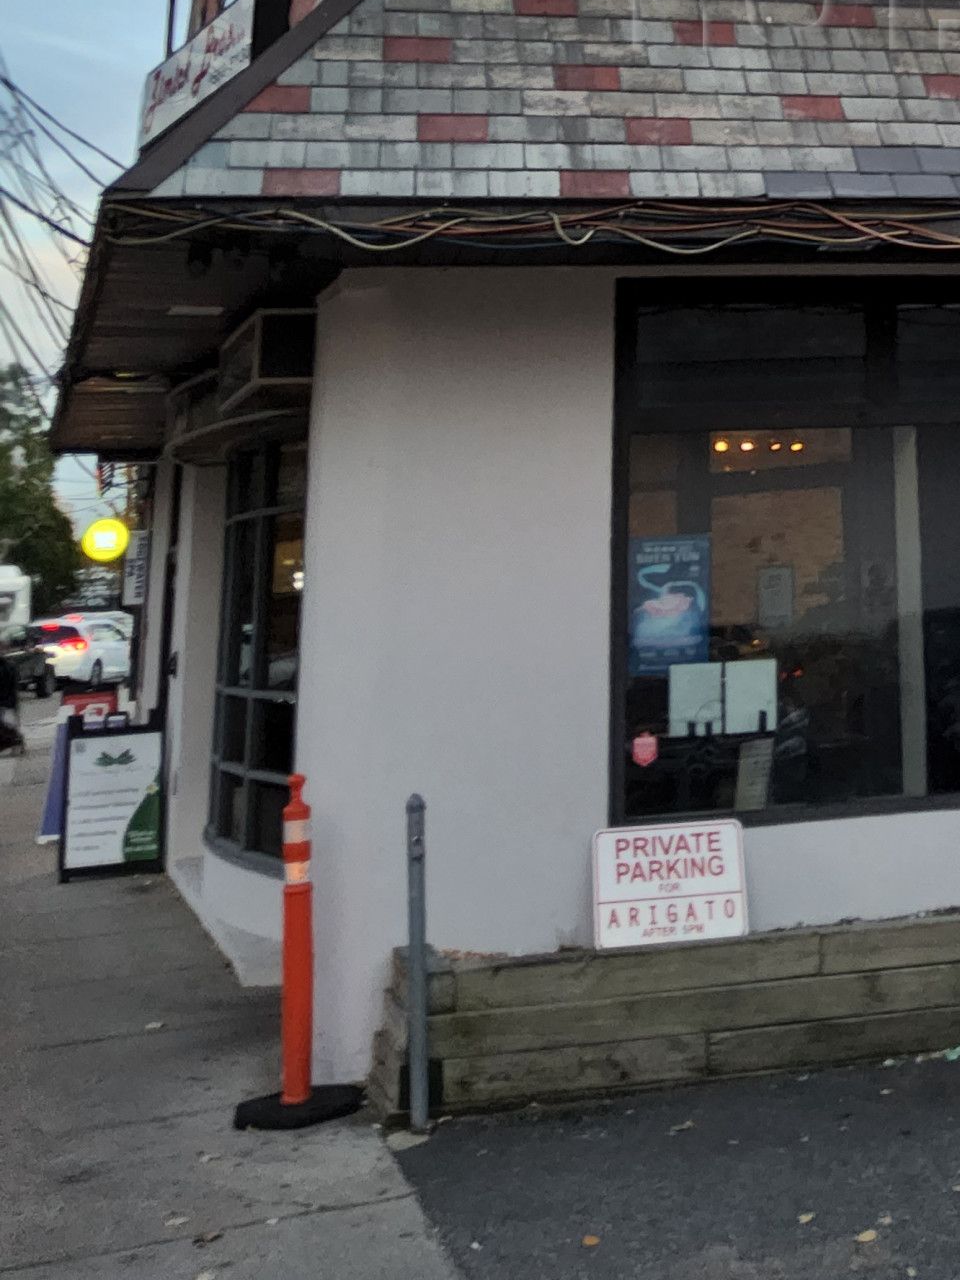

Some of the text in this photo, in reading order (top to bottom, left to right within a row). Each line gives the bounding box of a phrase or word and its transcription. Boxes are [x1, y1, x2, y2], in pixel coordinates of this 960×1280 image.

[614, 831, 723, 860] PRIVATE
[615, 855, 725, 885] PARKING
[607, 898, 736, 929] ARIGATO
